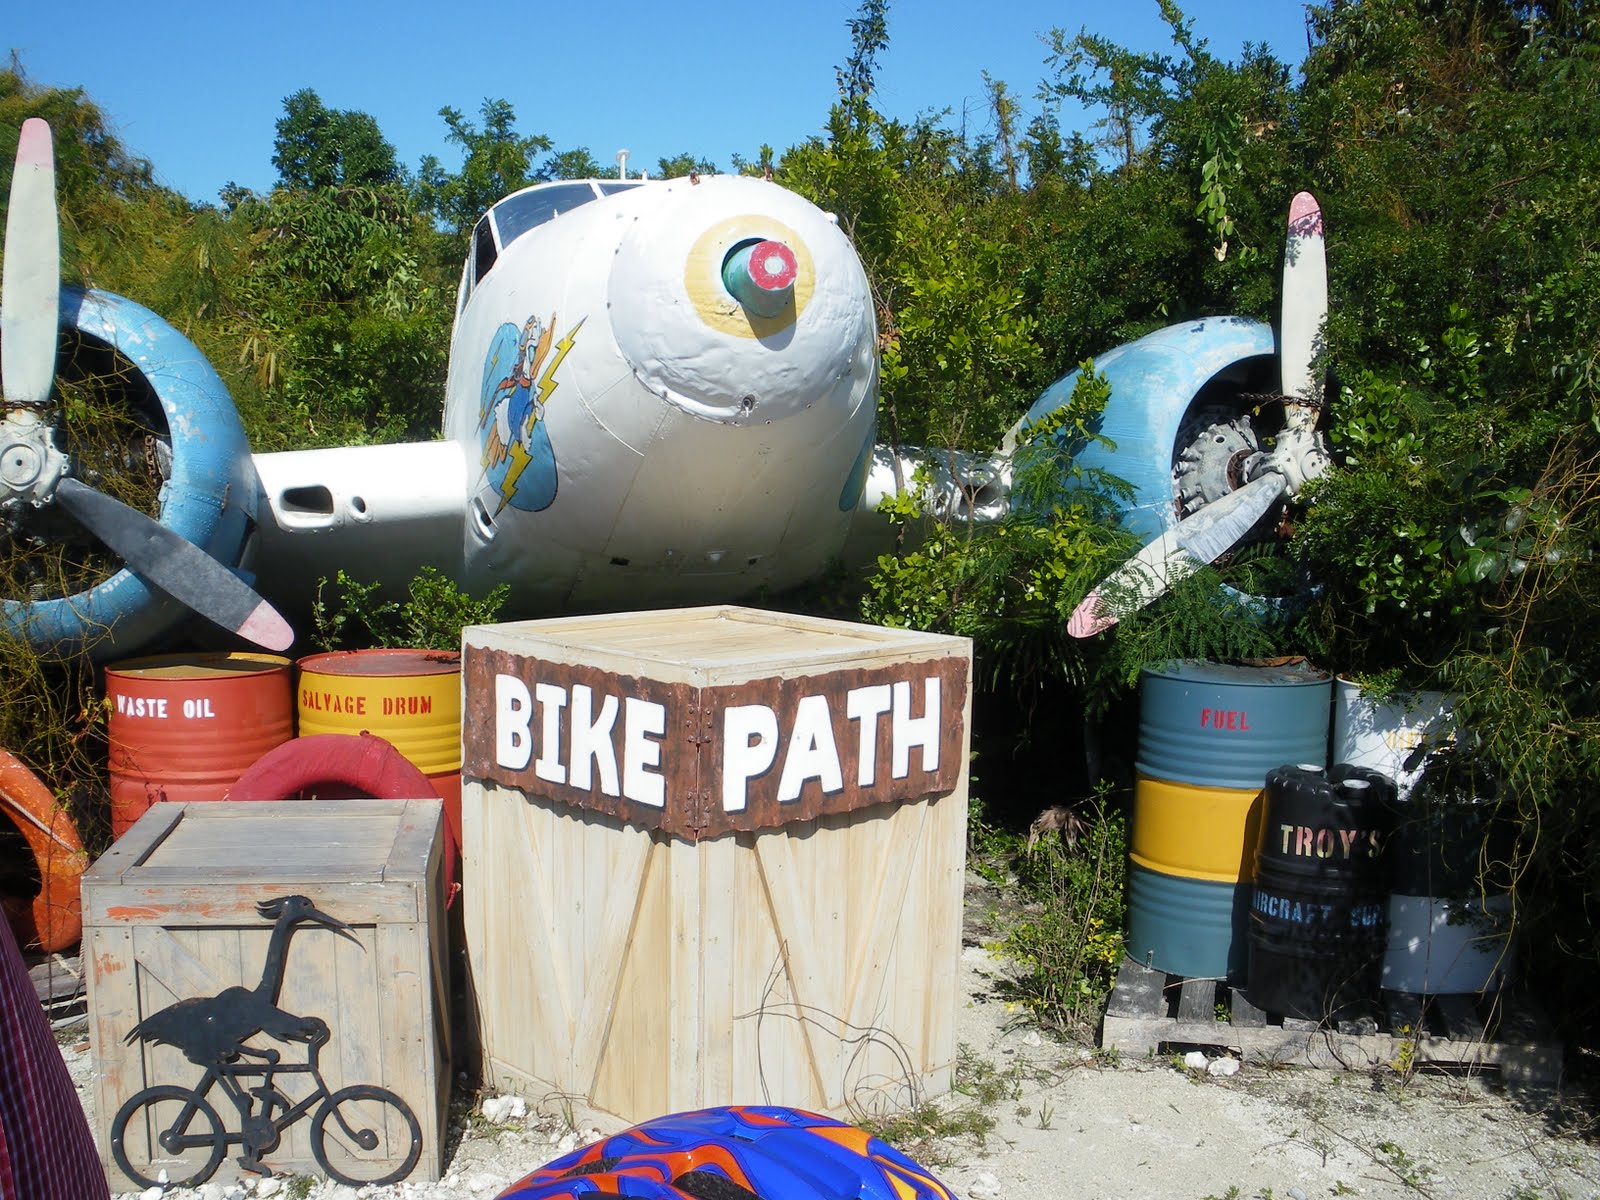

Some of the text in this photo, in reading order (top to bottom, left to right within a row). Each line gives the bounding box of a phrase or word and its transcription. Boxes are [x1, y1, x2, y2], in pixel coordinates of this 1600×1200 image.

[117, 694, 215, 719] WASTE OIL
[302, 689, 432, 716] SALVAGE DRUM
[1201, 708, 1251, 731] FUEL
[495, 673, 942, 812] BIKE PATH
[1280, 824, 1382, 860] TROY'S
